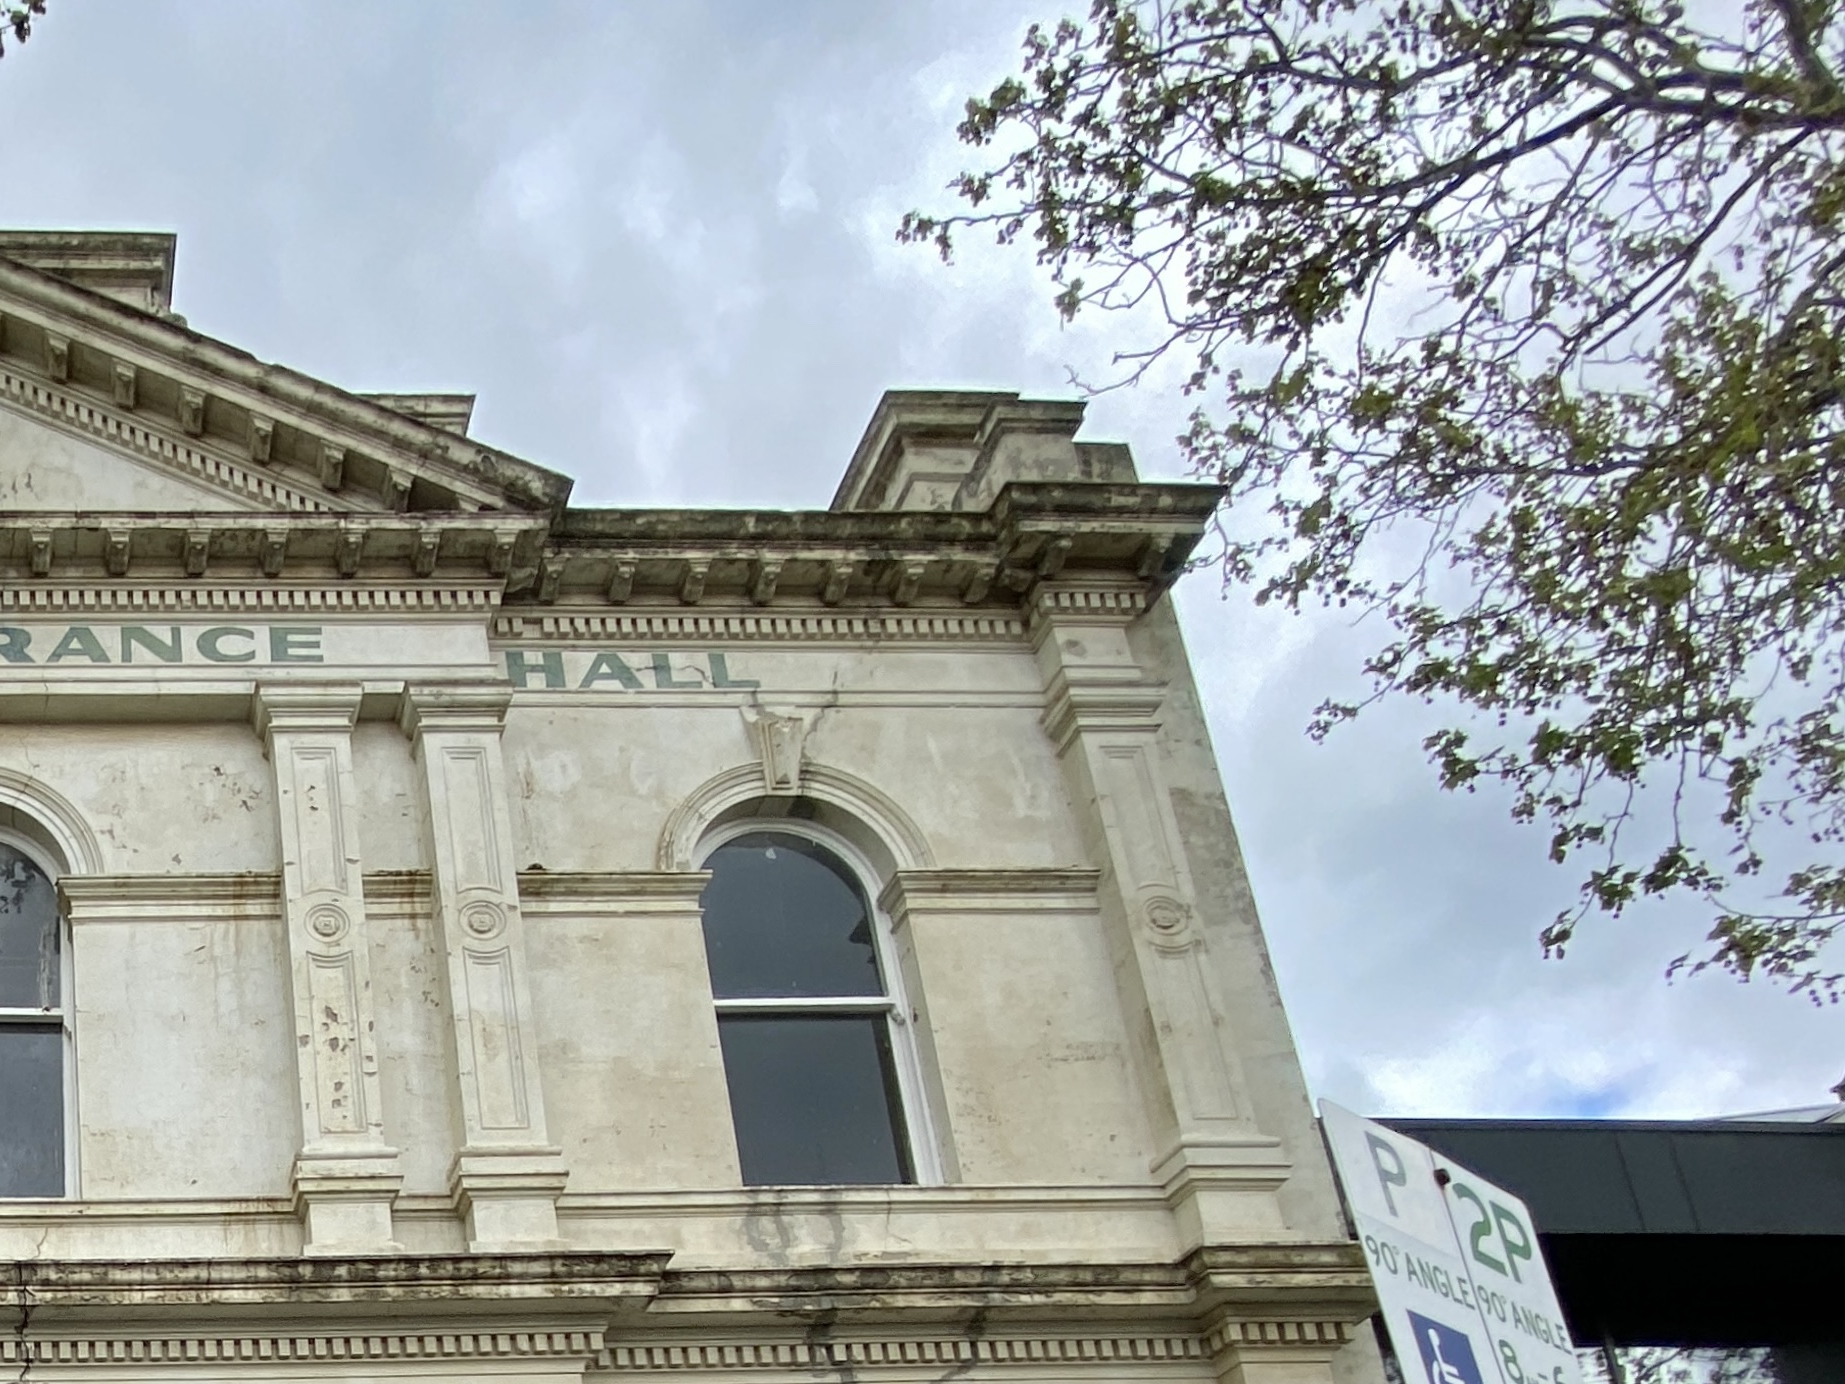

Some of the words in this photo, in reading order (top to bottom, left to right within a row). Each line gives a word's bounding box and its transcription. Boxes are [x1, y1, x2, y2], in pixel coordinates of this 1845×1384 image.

[505, 651, 761, 688] HALL
[1365, 1130, 1407, 1218] P
[1452, 1182, 1532, 1284] 2P
[1405, 1252, 1475, 1310] ANGLE
[1511, 1301, 1573, 1356] ANGLE
